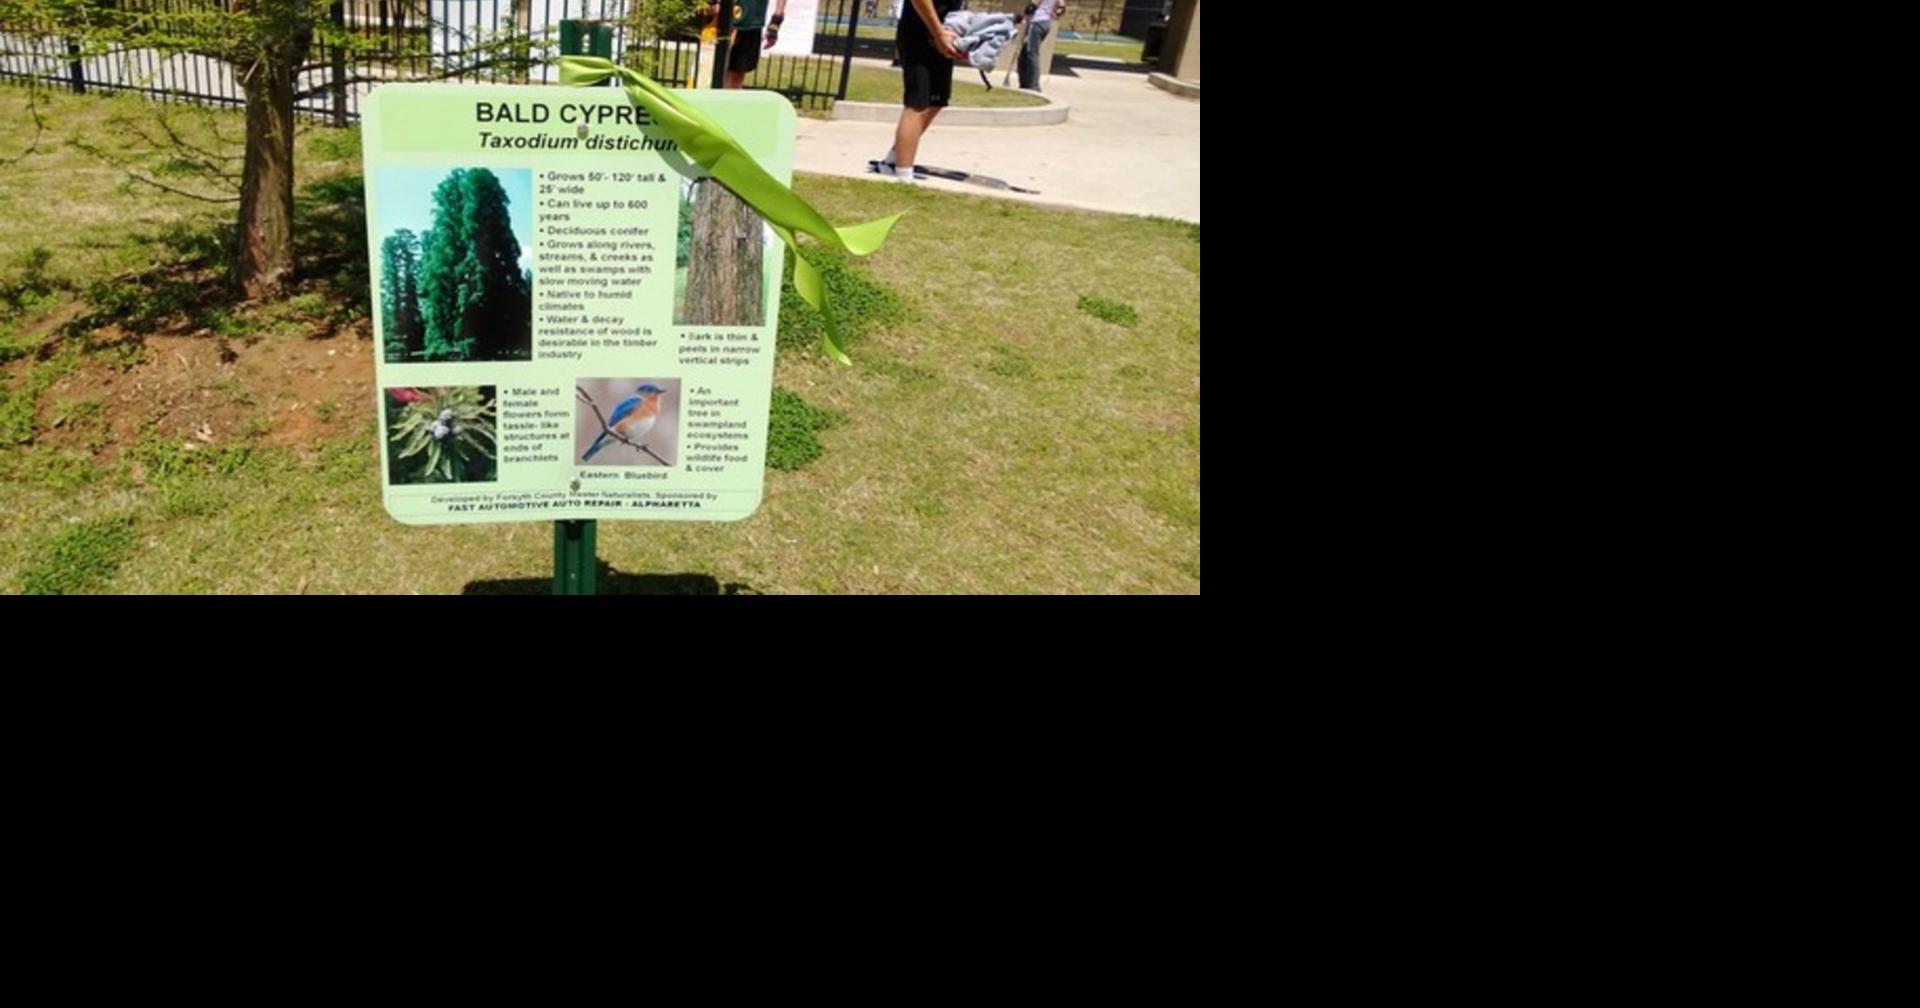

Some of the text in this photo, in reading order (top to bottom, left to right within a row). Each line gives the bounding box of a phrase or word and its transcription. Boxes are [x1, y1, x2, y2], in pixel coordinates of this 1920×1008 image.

[476, 102, 659, 125] BALD CYPRE
[479, 132, 579, 149] Taxodium
[547, 171, 585, 181] Grows
[637, 173, 655, 182] tall
[658, 173, 666, 182] &
[558, 185, 585, 194] wide
[547, 199, 648, 210] Can live up to 600
[539, 213, 570, 223] years
[547, 225, 649, 236] Deciduous conifer
[547, 239, 584, 249] Grows
[587, 240, 618, 251] along
[590, 253, 597, 261] &
[601, 253, 637, 261] creeks
[538, 265, 561, 273] well
[580, 266, 625, 275] swamps
[628, 265, 651, 273] with
[538, 277, 642, 287] slow moving water
[547, 290, 632, 299] Native to humid
[538, 302, 585, 311] climates
[546, 315, 625, 326] Water & decay
[538, 327, 653, 336] resistance of wood is
[727, 332, 748, 340] thin
[751, 333, 759, 341] &
[538, 339, 657, 347] desirable in the timber
[679, 345, 760, 354] peels in narrow
[538, 350, 582, 360] industry
[679, 356, 750, 366] vertical strips
[512, 387, 560, 396] Male and
[697, 386, 711, 395] An
[503, 399, 538, 407] female
[689, 398, 739, 407] important
[503, 410, 570, 418] flowers form
[688, 409, 708, 417] tree
[540, 422, 559, 430] like
[688, 420, 747, 430] swampland
[503, 432, 570, 441] structures at
[687, 431, 749, 441] ecosystems
[503, 443, 543, 452] ends of
[693, 442, 739, 451] Provides
[503, 454, 559, 463] branchlets
[686, 453, 748, 462] wildlife food
[685, 464, 693, 472] &
[580, 471, 668, 479] Eastern Bluebird
[483, 494, 494, 502] by
[655, 491, 705, 499] Sponsored
[706, 492, 718, 501] by
[448, 503, 476, 512] FAST
[478, 501, 549, 511] AUTOMOTIVE
[552, 500, 581, 508] AUTO
